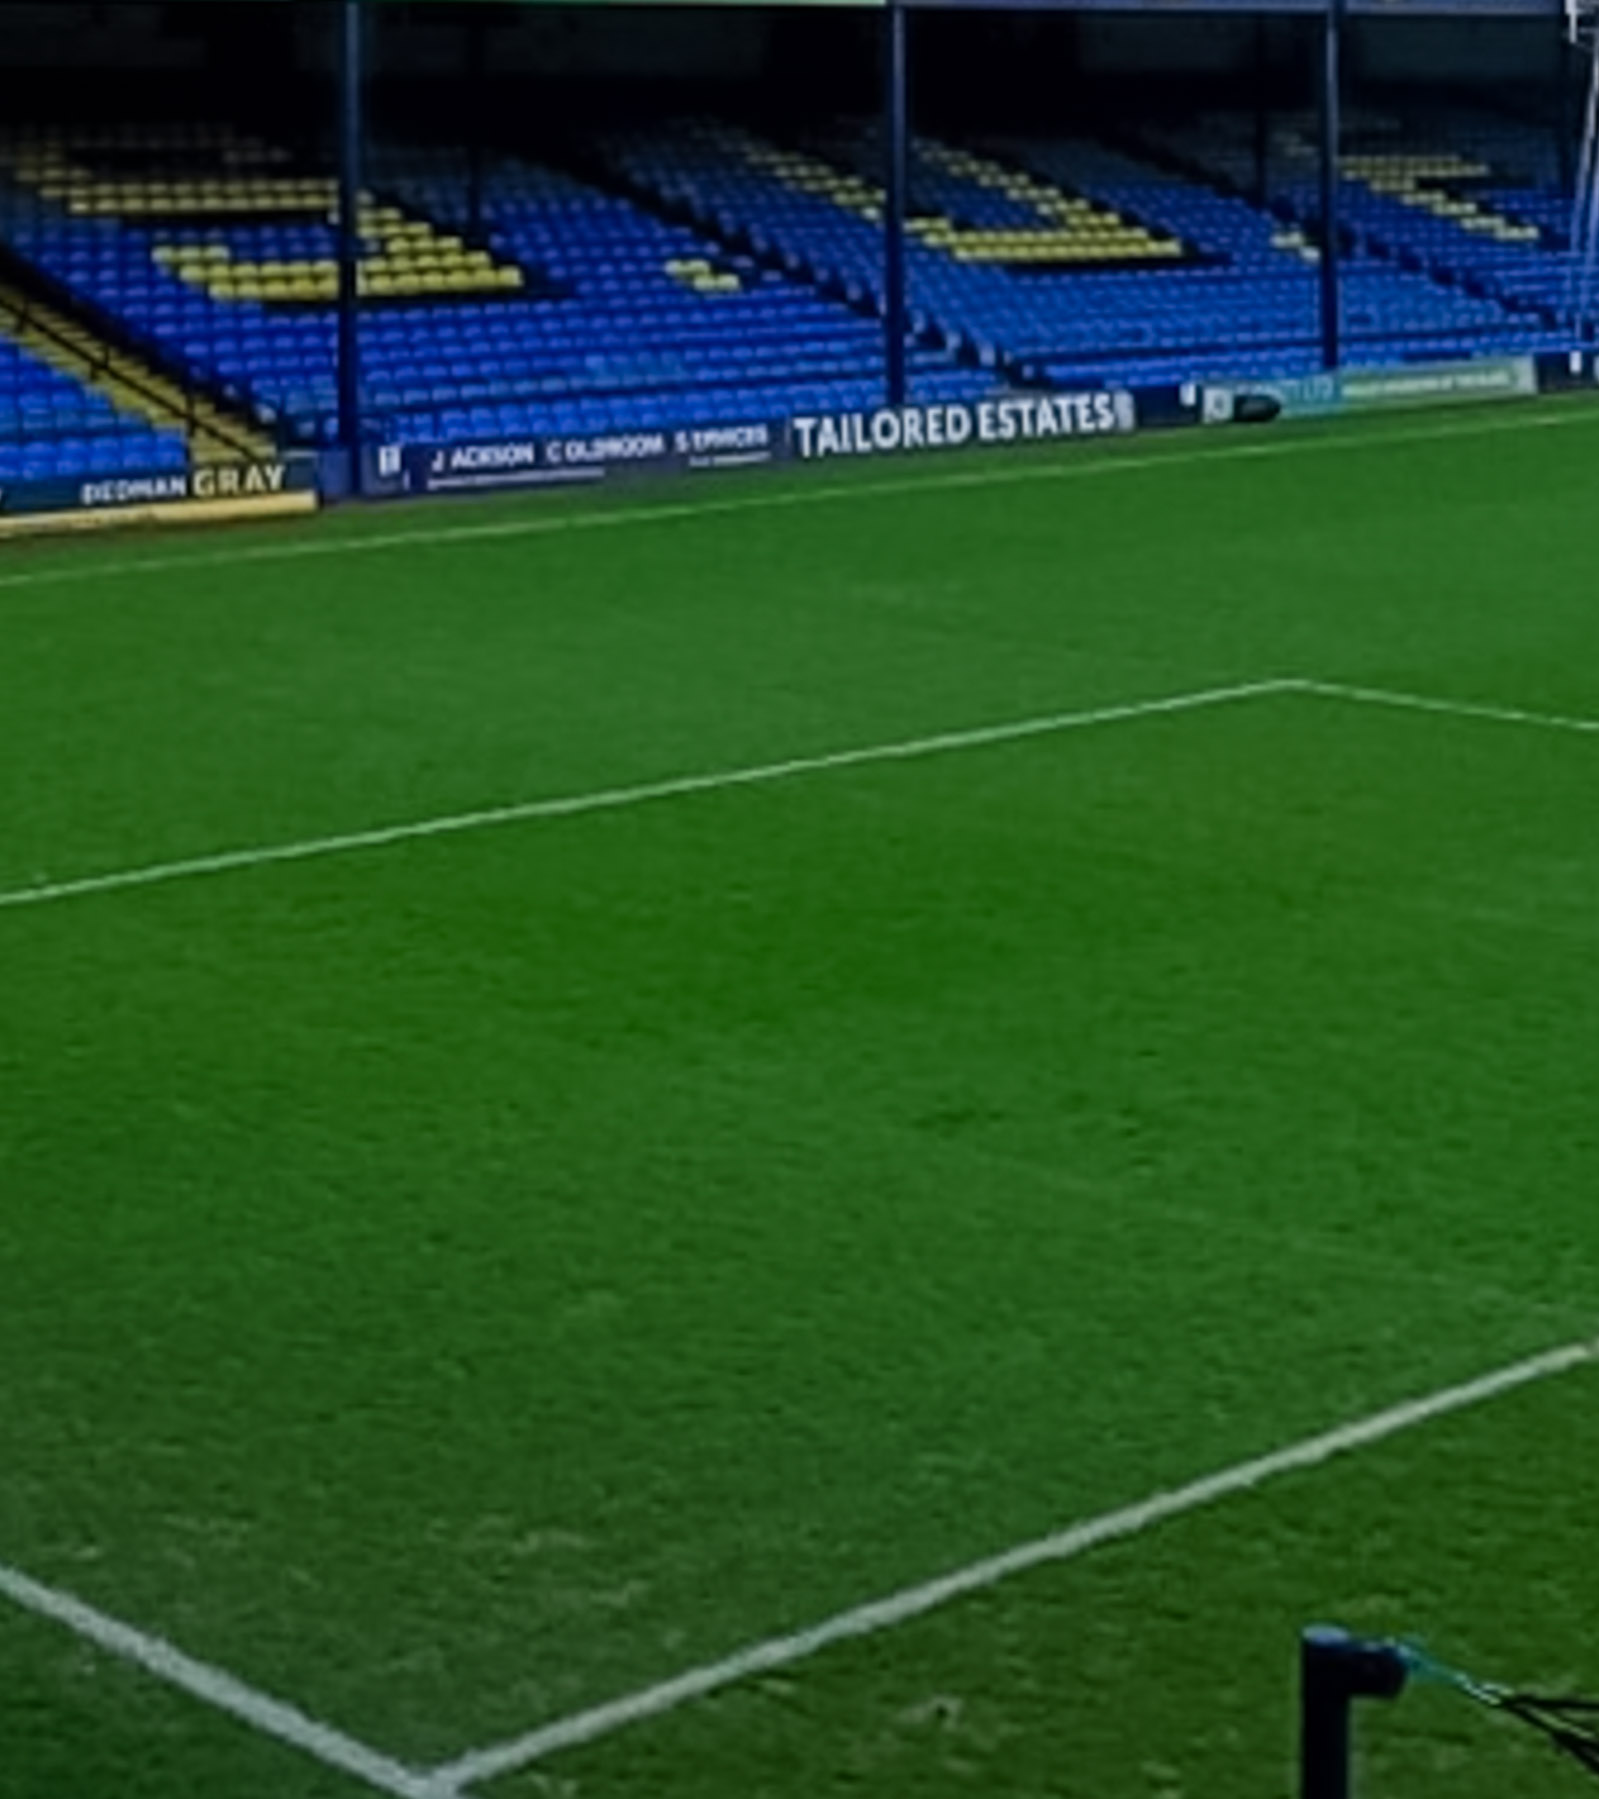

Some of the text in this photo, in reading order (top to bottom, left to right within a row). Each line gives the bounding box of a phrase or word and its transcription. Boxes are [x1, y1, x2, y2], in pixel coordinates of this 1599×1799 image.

[793, 404, 972, 457] TAILORED
[977, 393, 1116, 441] ESTATES
[193, 464, 286, 497] GRAY
